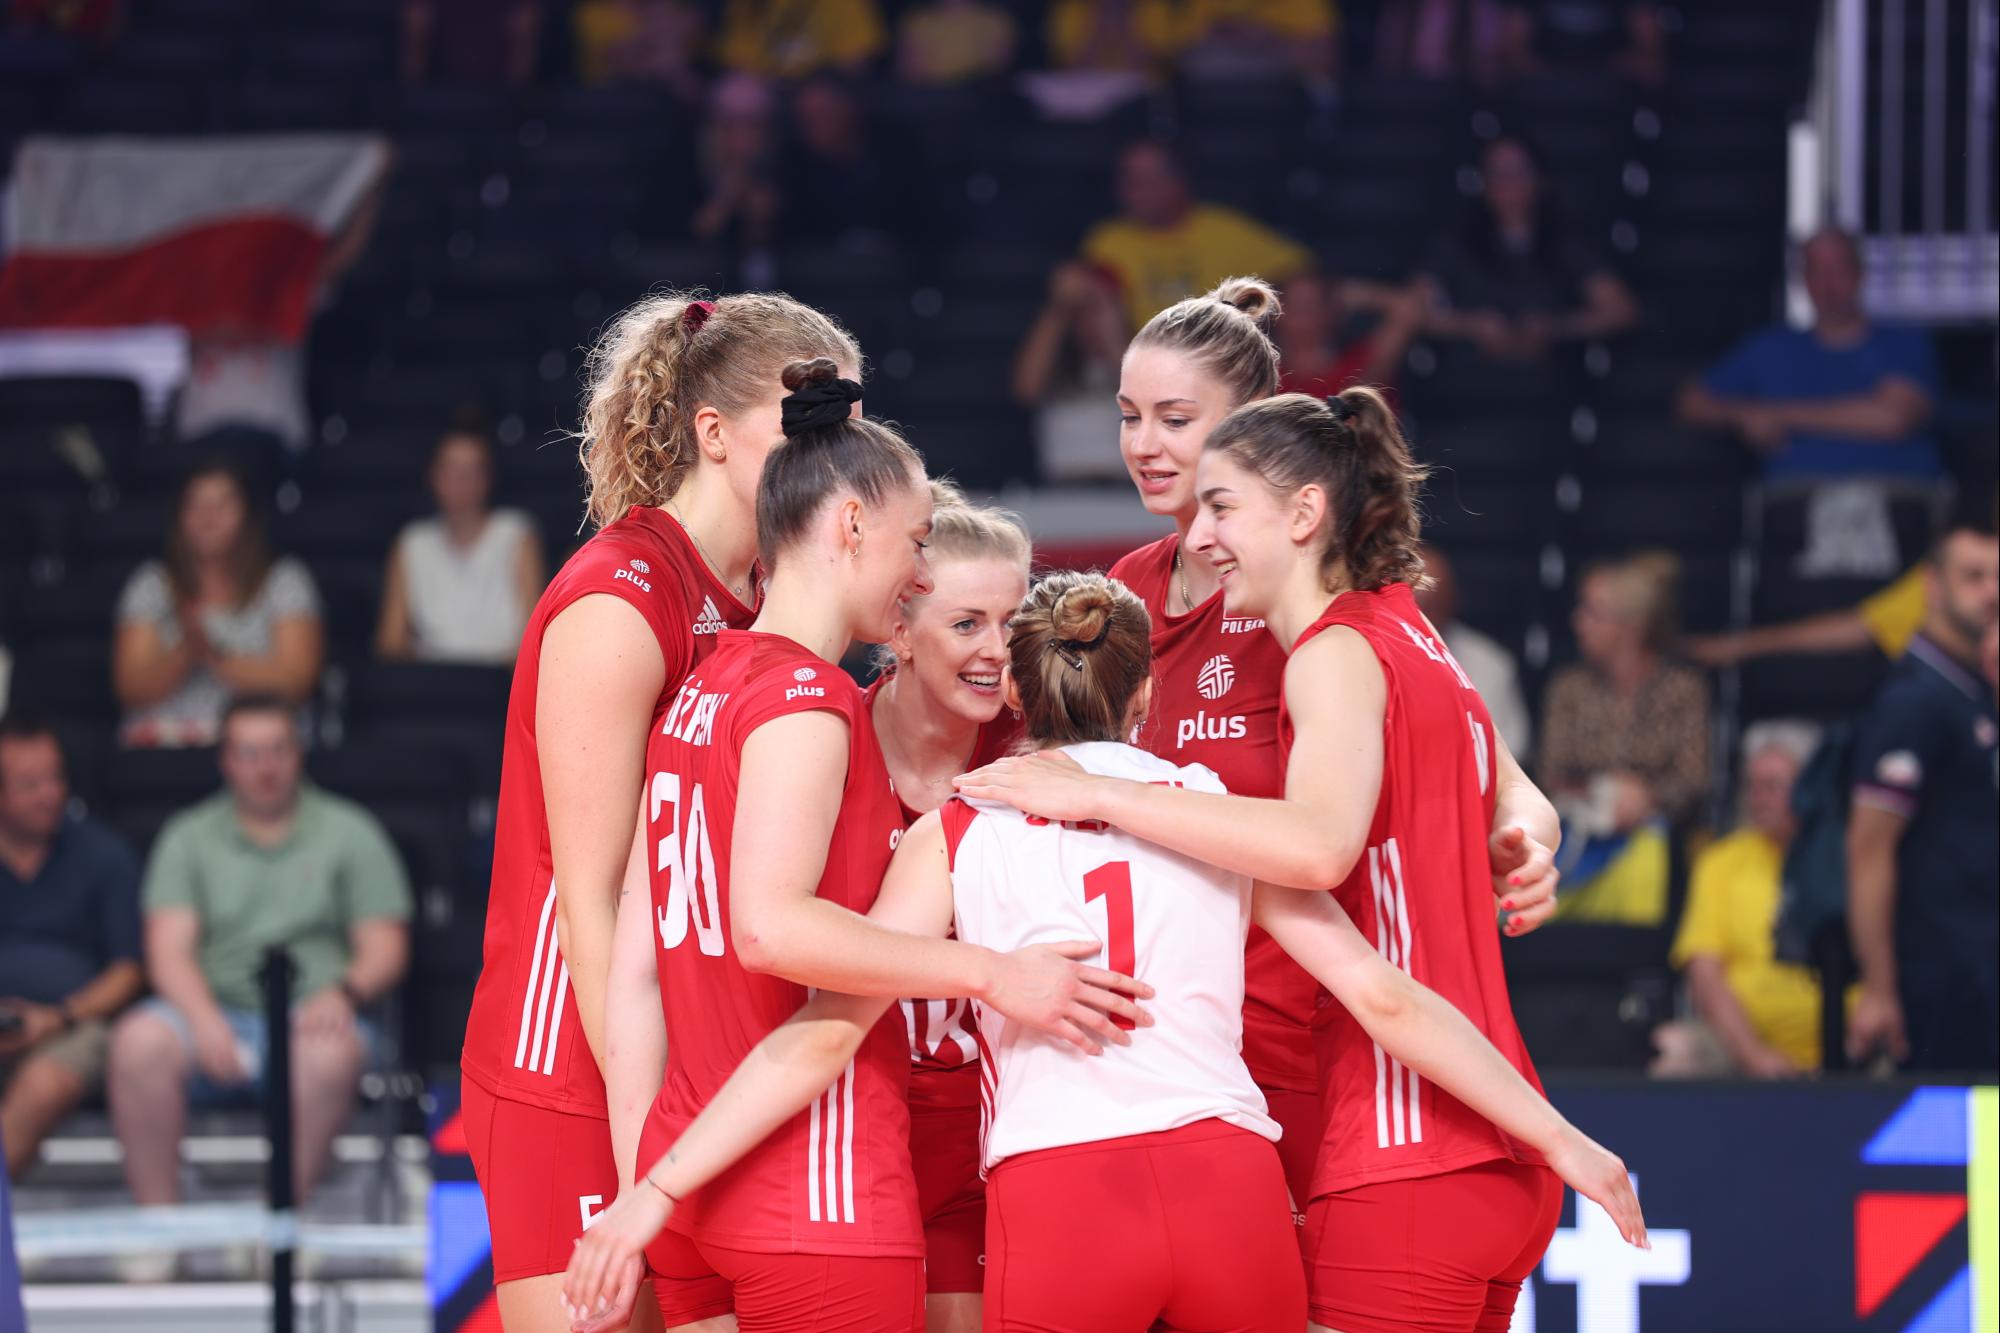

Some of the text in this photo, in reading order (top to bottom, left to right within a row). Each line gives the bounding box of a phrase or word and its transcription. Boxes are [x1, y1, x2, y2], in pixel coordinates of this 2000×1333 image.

[613, 569, 652, 593] plus
[785, 684, 825, 701] plus
[1176, 710, 1247, 749] plus
[651, 771, 725, 957] 30
[1083, 860, 1136, 1031] 1
